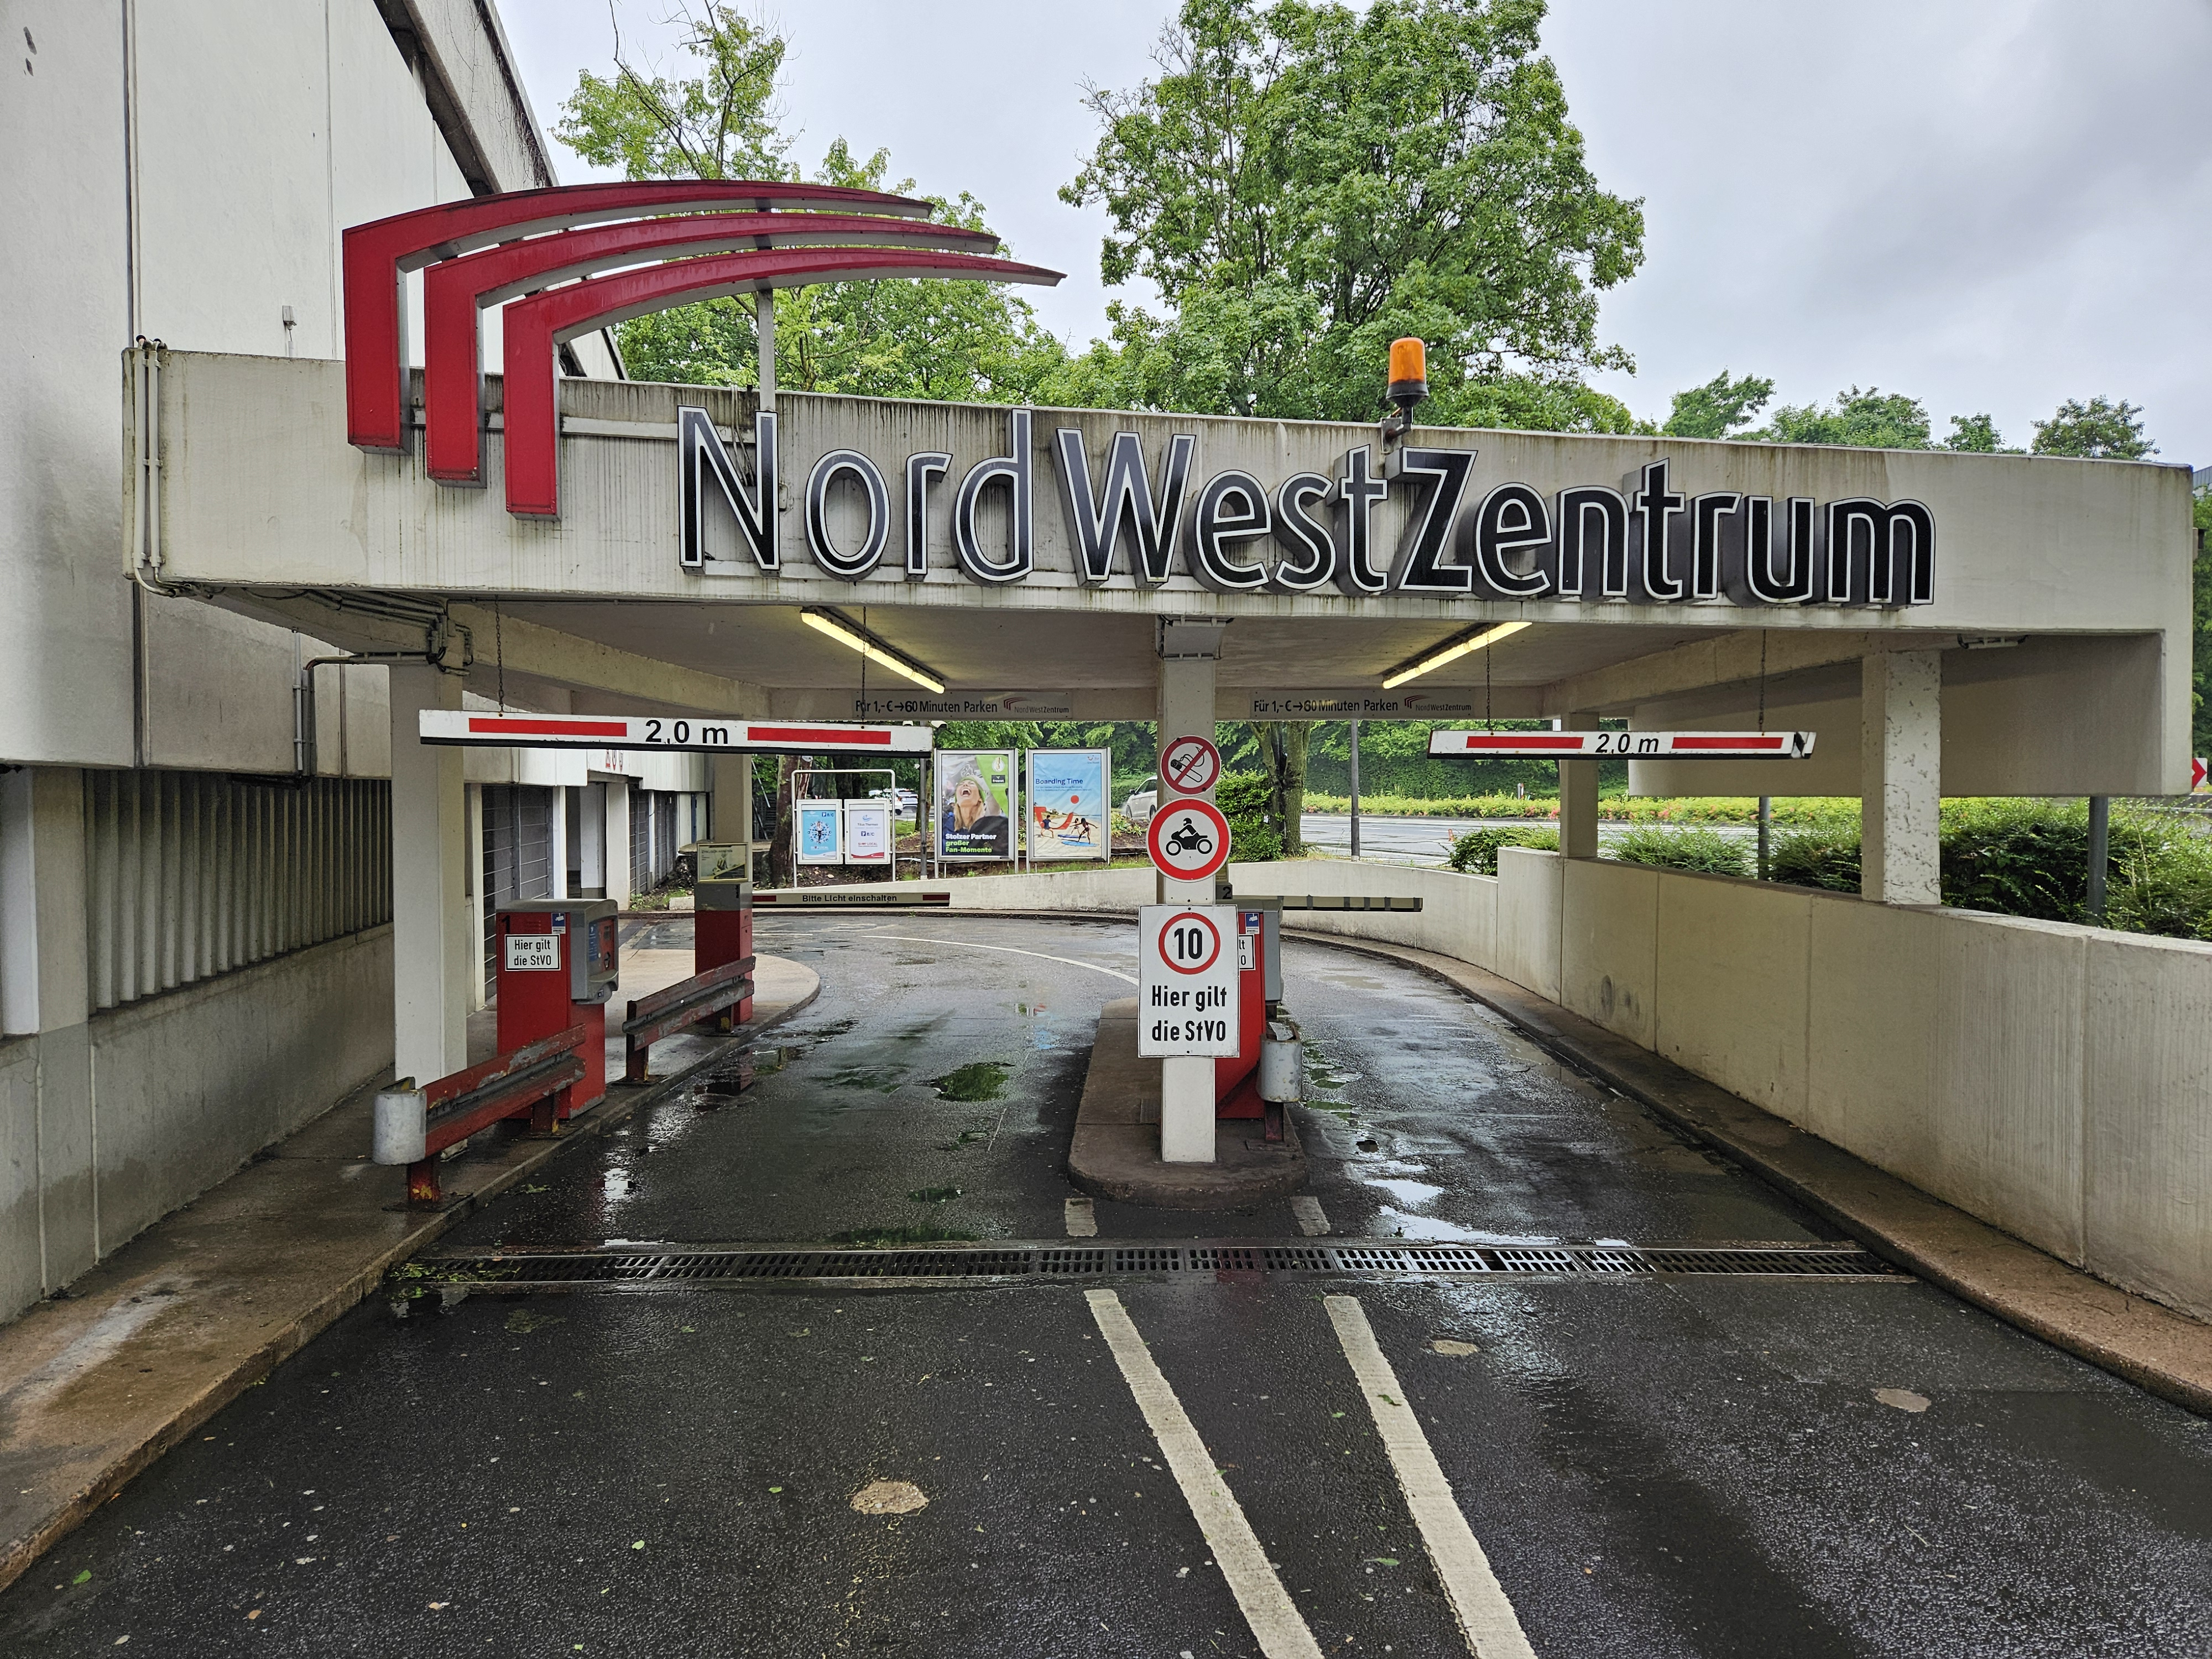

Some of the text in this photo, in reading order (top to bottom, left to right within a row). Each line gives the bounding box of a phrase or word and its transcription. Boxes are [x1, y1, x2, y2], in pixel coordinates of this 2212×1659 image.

[855, 700, 871, 712] Fr
[905, 701, 918, 712] 60
[920, 700, 960, 712] Minuten
[964, 700, 998, 712] Parken
[1254, 700, 1269, 712] Für
[1303, 700, 1317, 712] 60
[1319, 700, 1359, 711] Minuten
[1364, 698, 1398, 711] Parken
[645, 719, 728, 744] 2,0 m
[1595, 733, 1659, 754] 2,0 m
[1223, 886, 1232, 899] 2
[502, 915, 510, 933] 1
[514, 940, 550, 952] Hier gilt
[1174, 928, 1202, 959] 10
[514, 955, 551, 966] die StVO
[1152, 985, 1227, 1012] Hier gilt
[1152, 1020, 1225, 1041] die StVO
